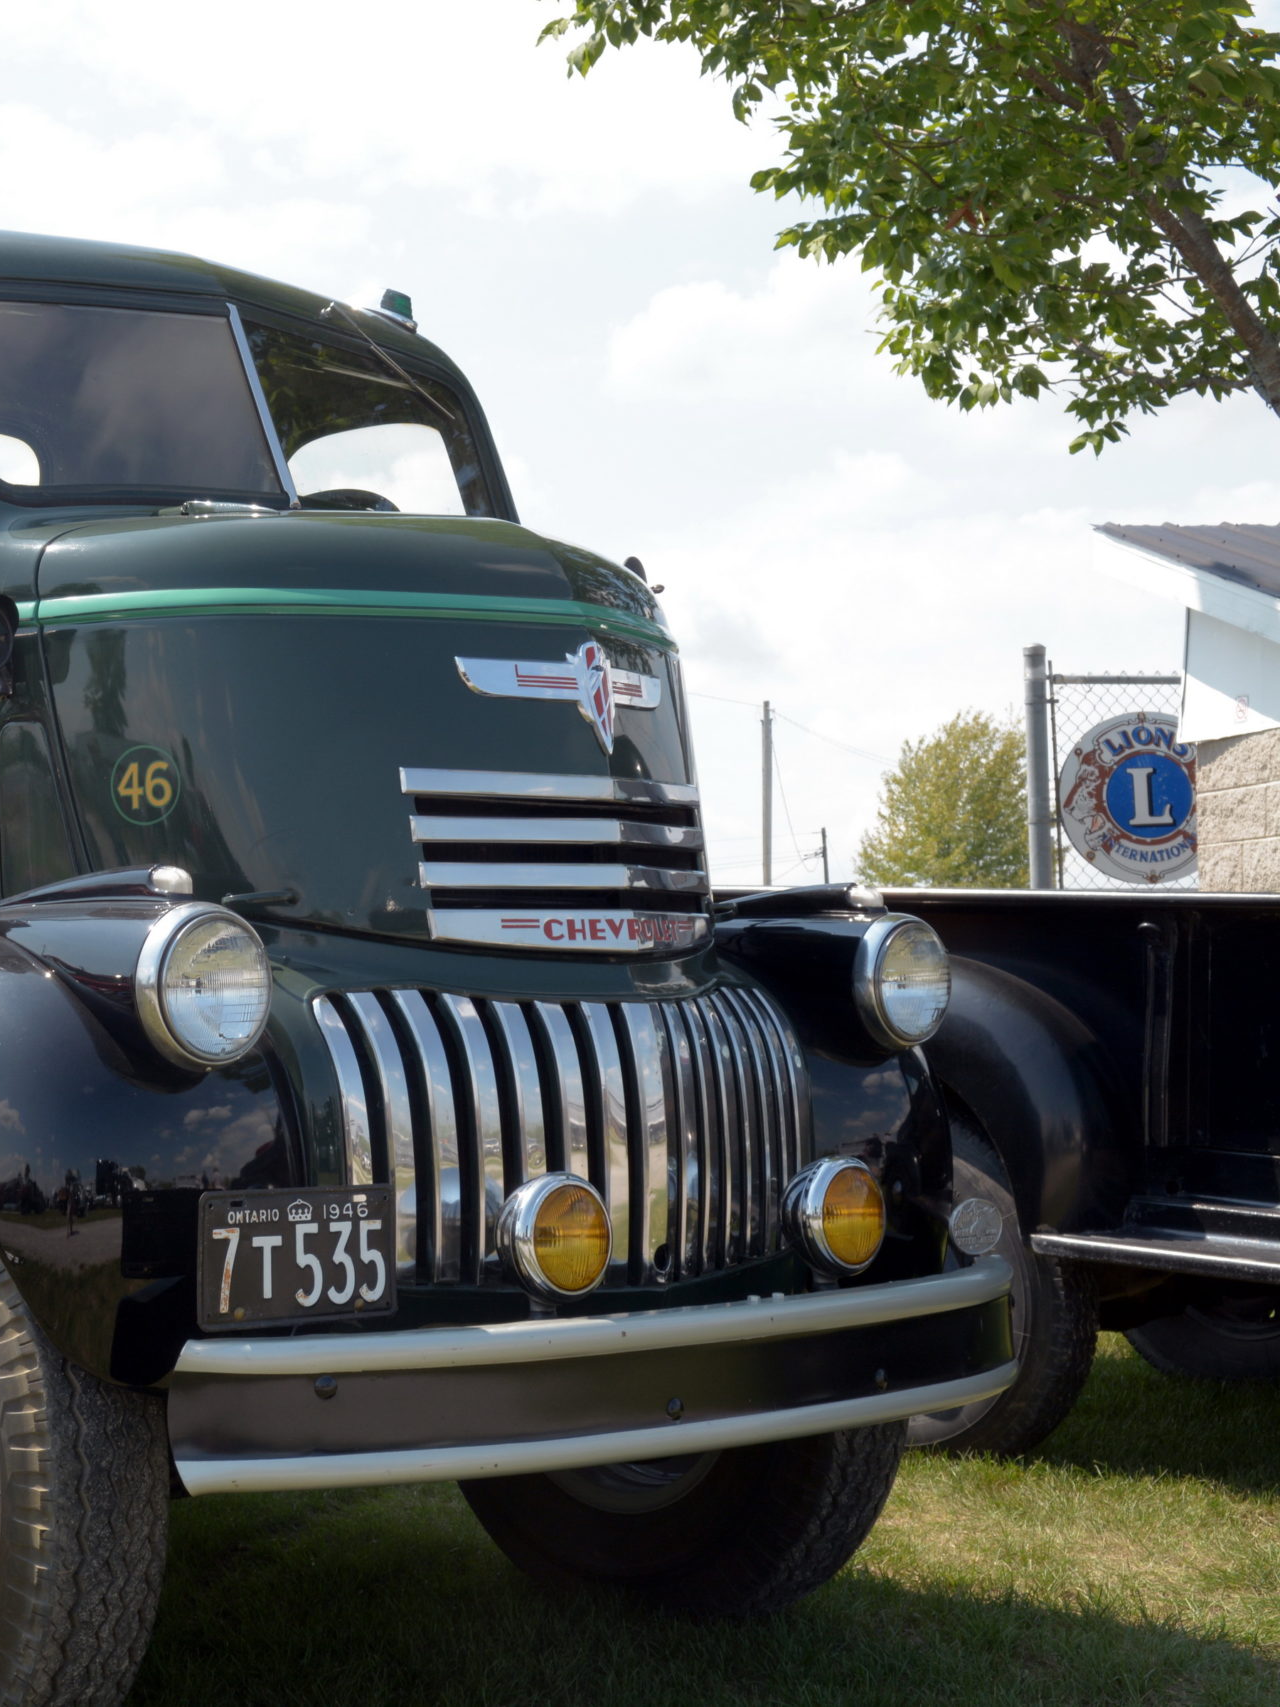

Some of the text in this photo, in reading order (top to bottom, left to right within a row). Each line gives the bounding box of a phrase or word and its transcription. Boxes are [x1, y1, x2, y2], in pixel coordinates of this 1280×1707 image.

[118, 761, 172, 810] 46
[1126, 767, 1175, 827] L
[543, 918, 678, 942] CHEVROLET
[228, 1203, 369, 1224] ONTARIO 1946
